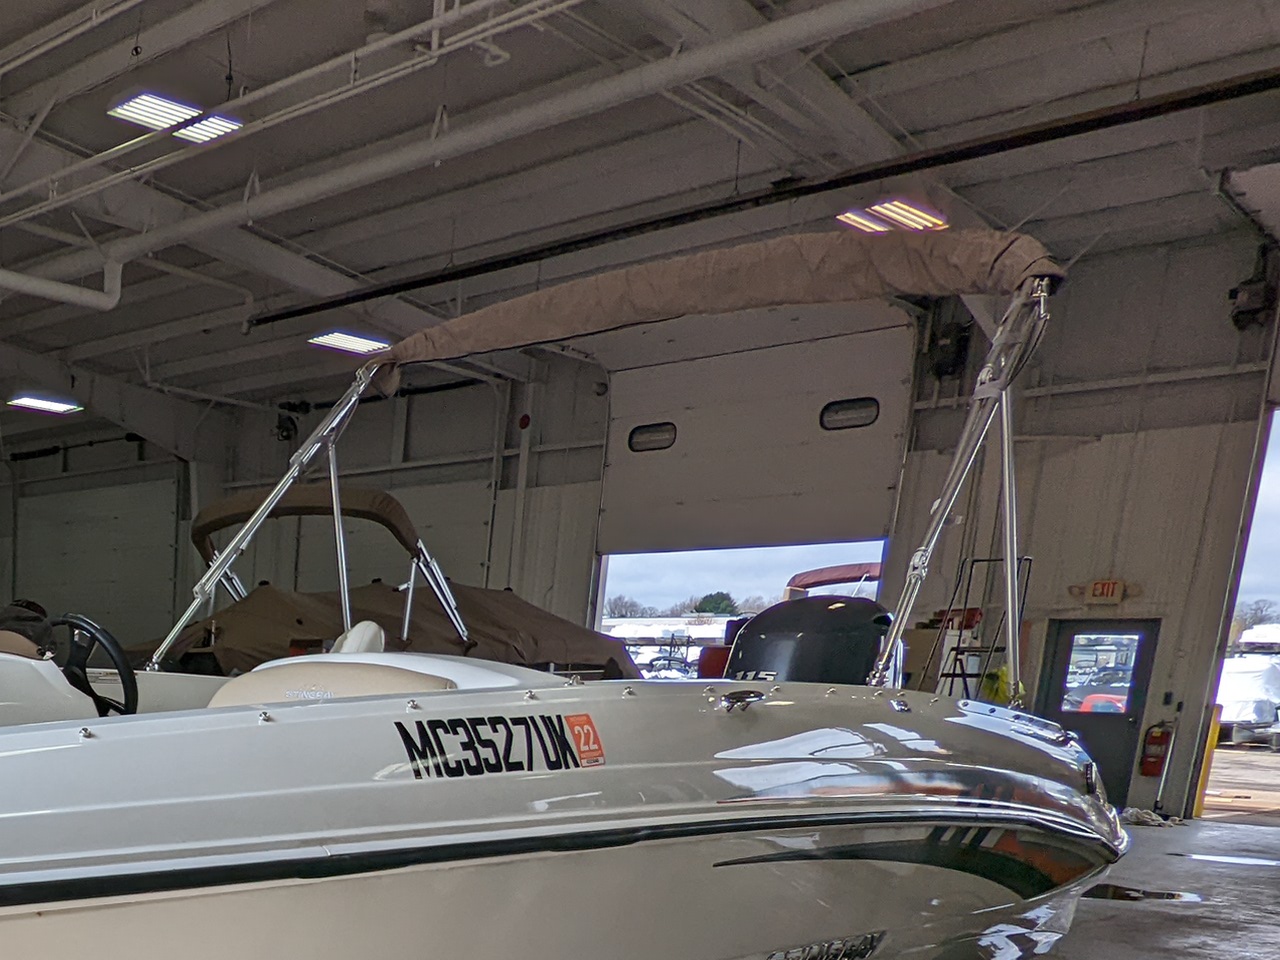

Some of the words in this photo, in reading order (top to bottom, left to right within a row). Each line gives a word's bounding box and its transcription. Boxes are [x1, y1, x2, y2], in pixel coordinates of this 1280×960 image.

[1092, 581, 1119, 598] EXIT
[735, 670, 778, 682] 115
[394, 714, 581, 780] MC3527UK
[574, 724, 599, 752] 22
